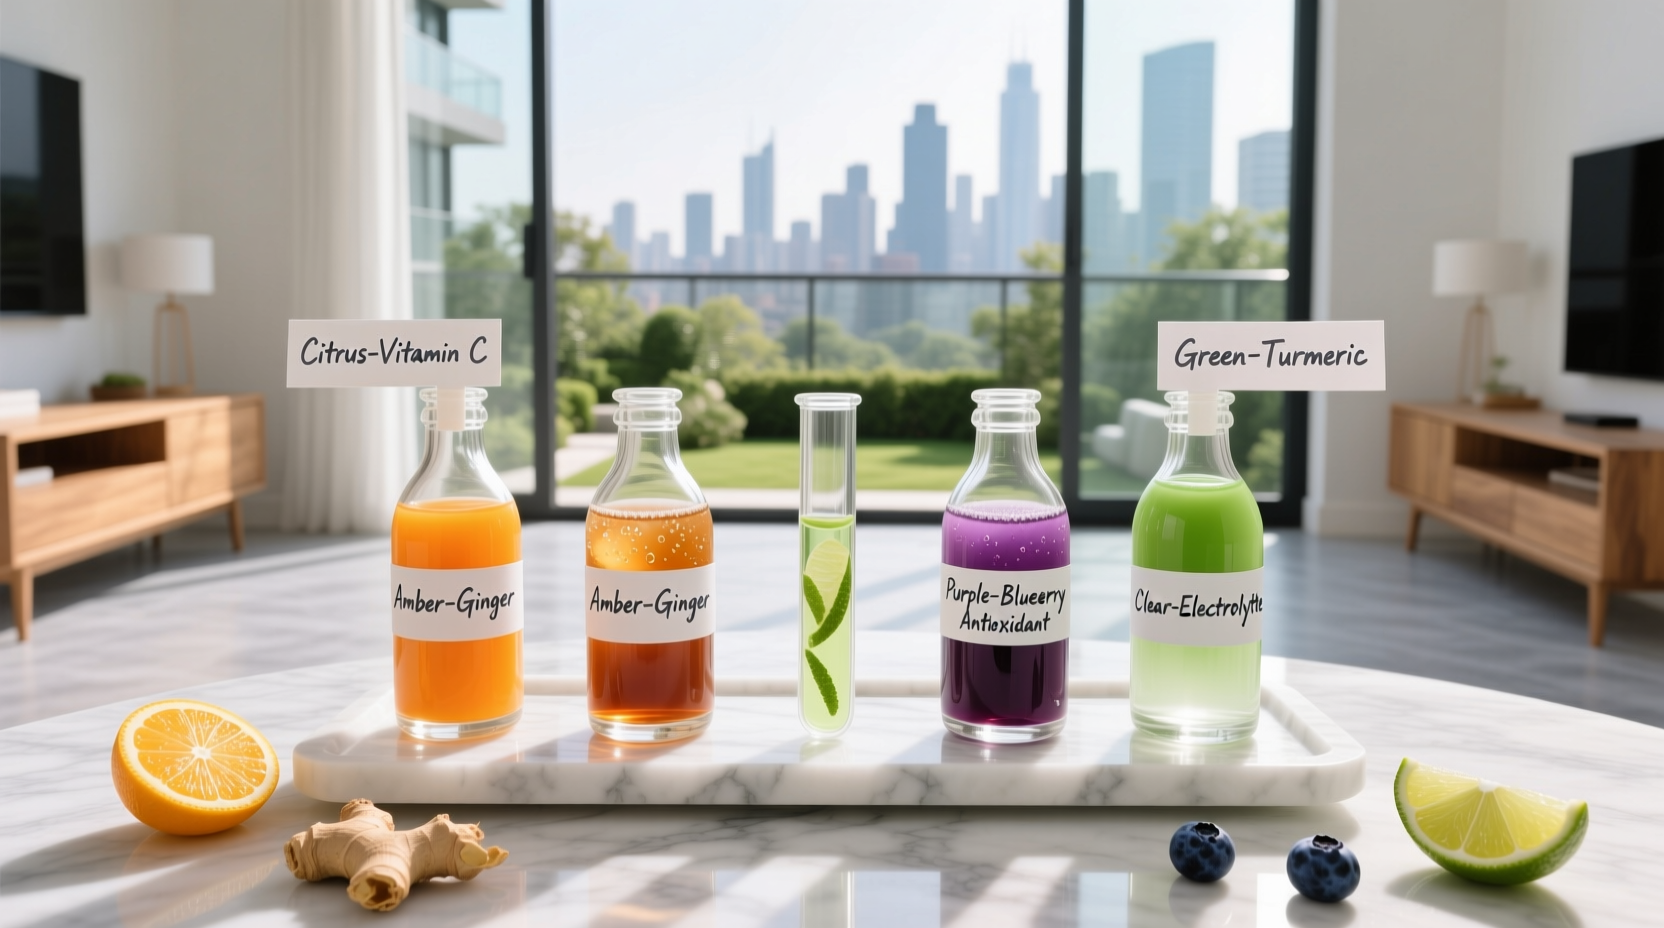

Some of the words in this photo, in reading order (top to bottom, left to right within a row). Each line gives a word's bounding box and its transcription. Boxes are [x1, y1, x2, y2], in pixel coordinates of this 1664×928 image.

[300, 336, 459, 366] Citrus-Vitamin
[469, 335, 488, 364] C
[1174, 337, 1368, 371] Green-Turmeric
[393, 583, 515, 621] Amber-Ginger
[589, 585, 710, 624] Amber-Ginger
[959, 609, 1051, 633] Antioxidant
